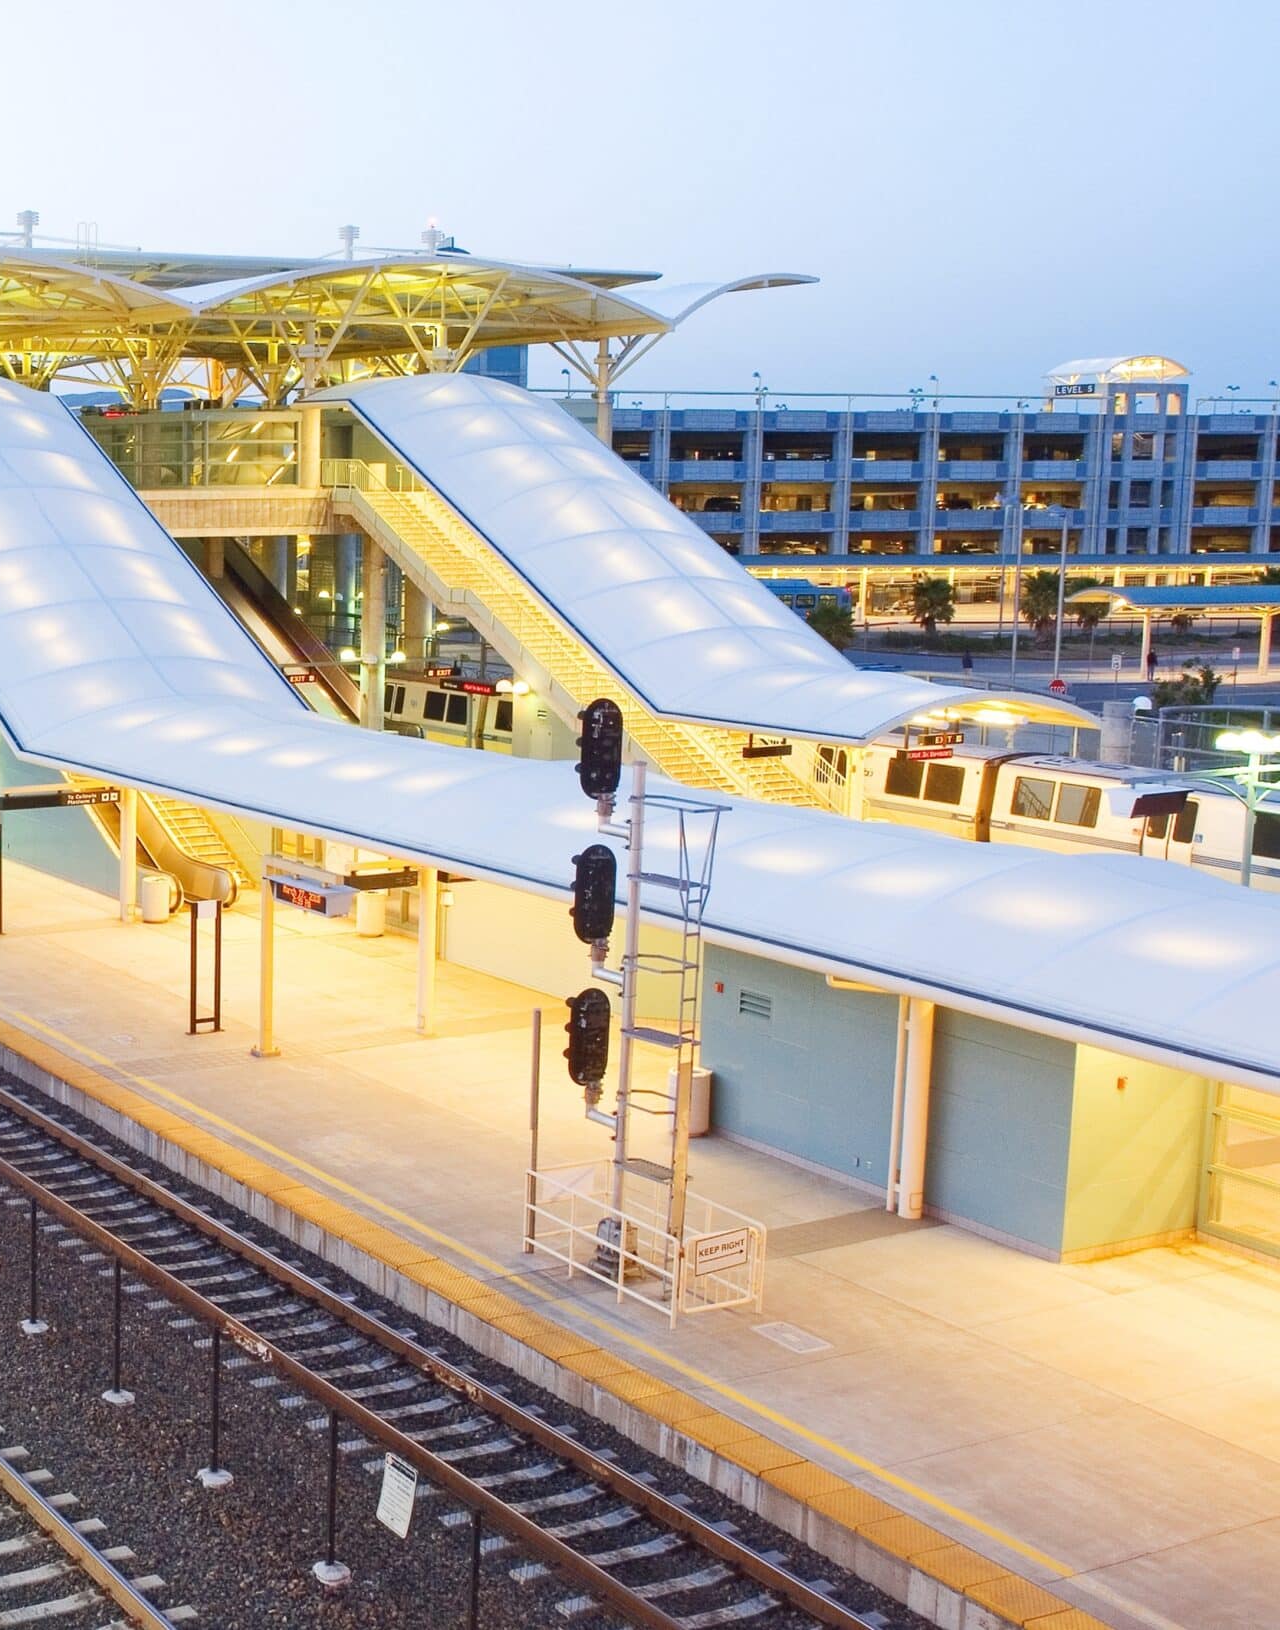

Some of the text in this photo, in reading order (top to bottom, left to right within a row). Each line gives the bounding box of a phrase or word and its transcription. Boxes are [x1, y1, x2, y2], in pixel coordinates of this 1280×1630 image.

[1056, 386, 1083, 395] LEVEL
[290, 675, 305, 683] EXIT
[699, 1239, 745, 1257] KEEP RIGHT
